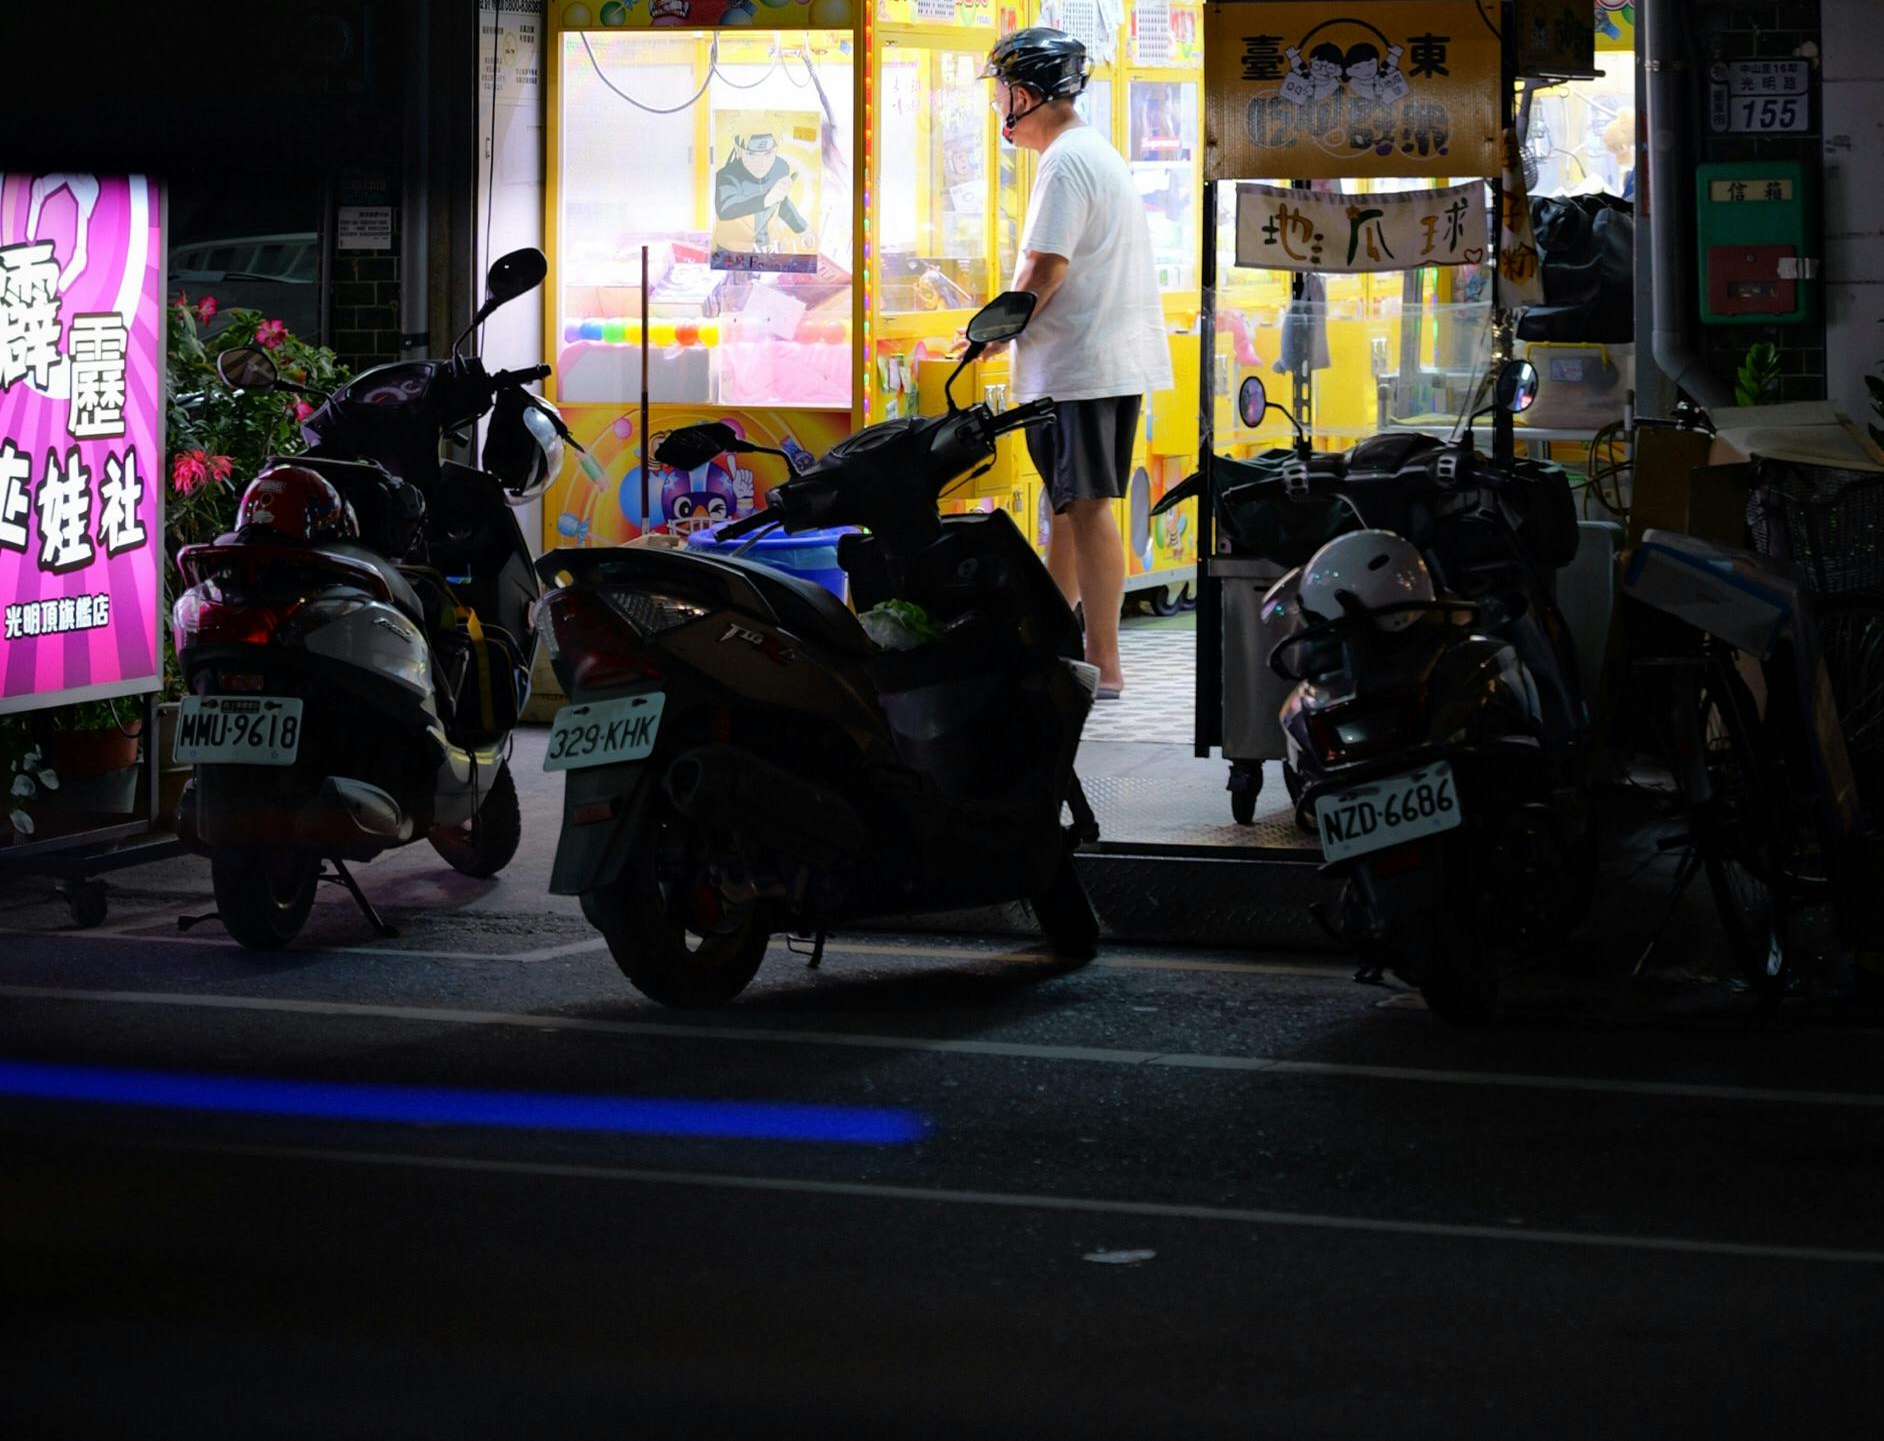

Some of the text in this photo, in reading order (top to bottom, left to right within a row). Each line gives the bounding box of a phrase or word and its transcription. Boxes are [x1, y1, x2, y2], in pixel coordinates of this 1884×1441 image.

[1407, 32, 1450, 78] 東
[1740, 76, 1797, 91] 光明路
[1743, 99, 1797, 129] 155
[1728, 181, 1782, 201] 信箱
[1261, 197, 1468, 267] 地瓜球
[4, 594, 110, 639] 光明頂旗艦店
